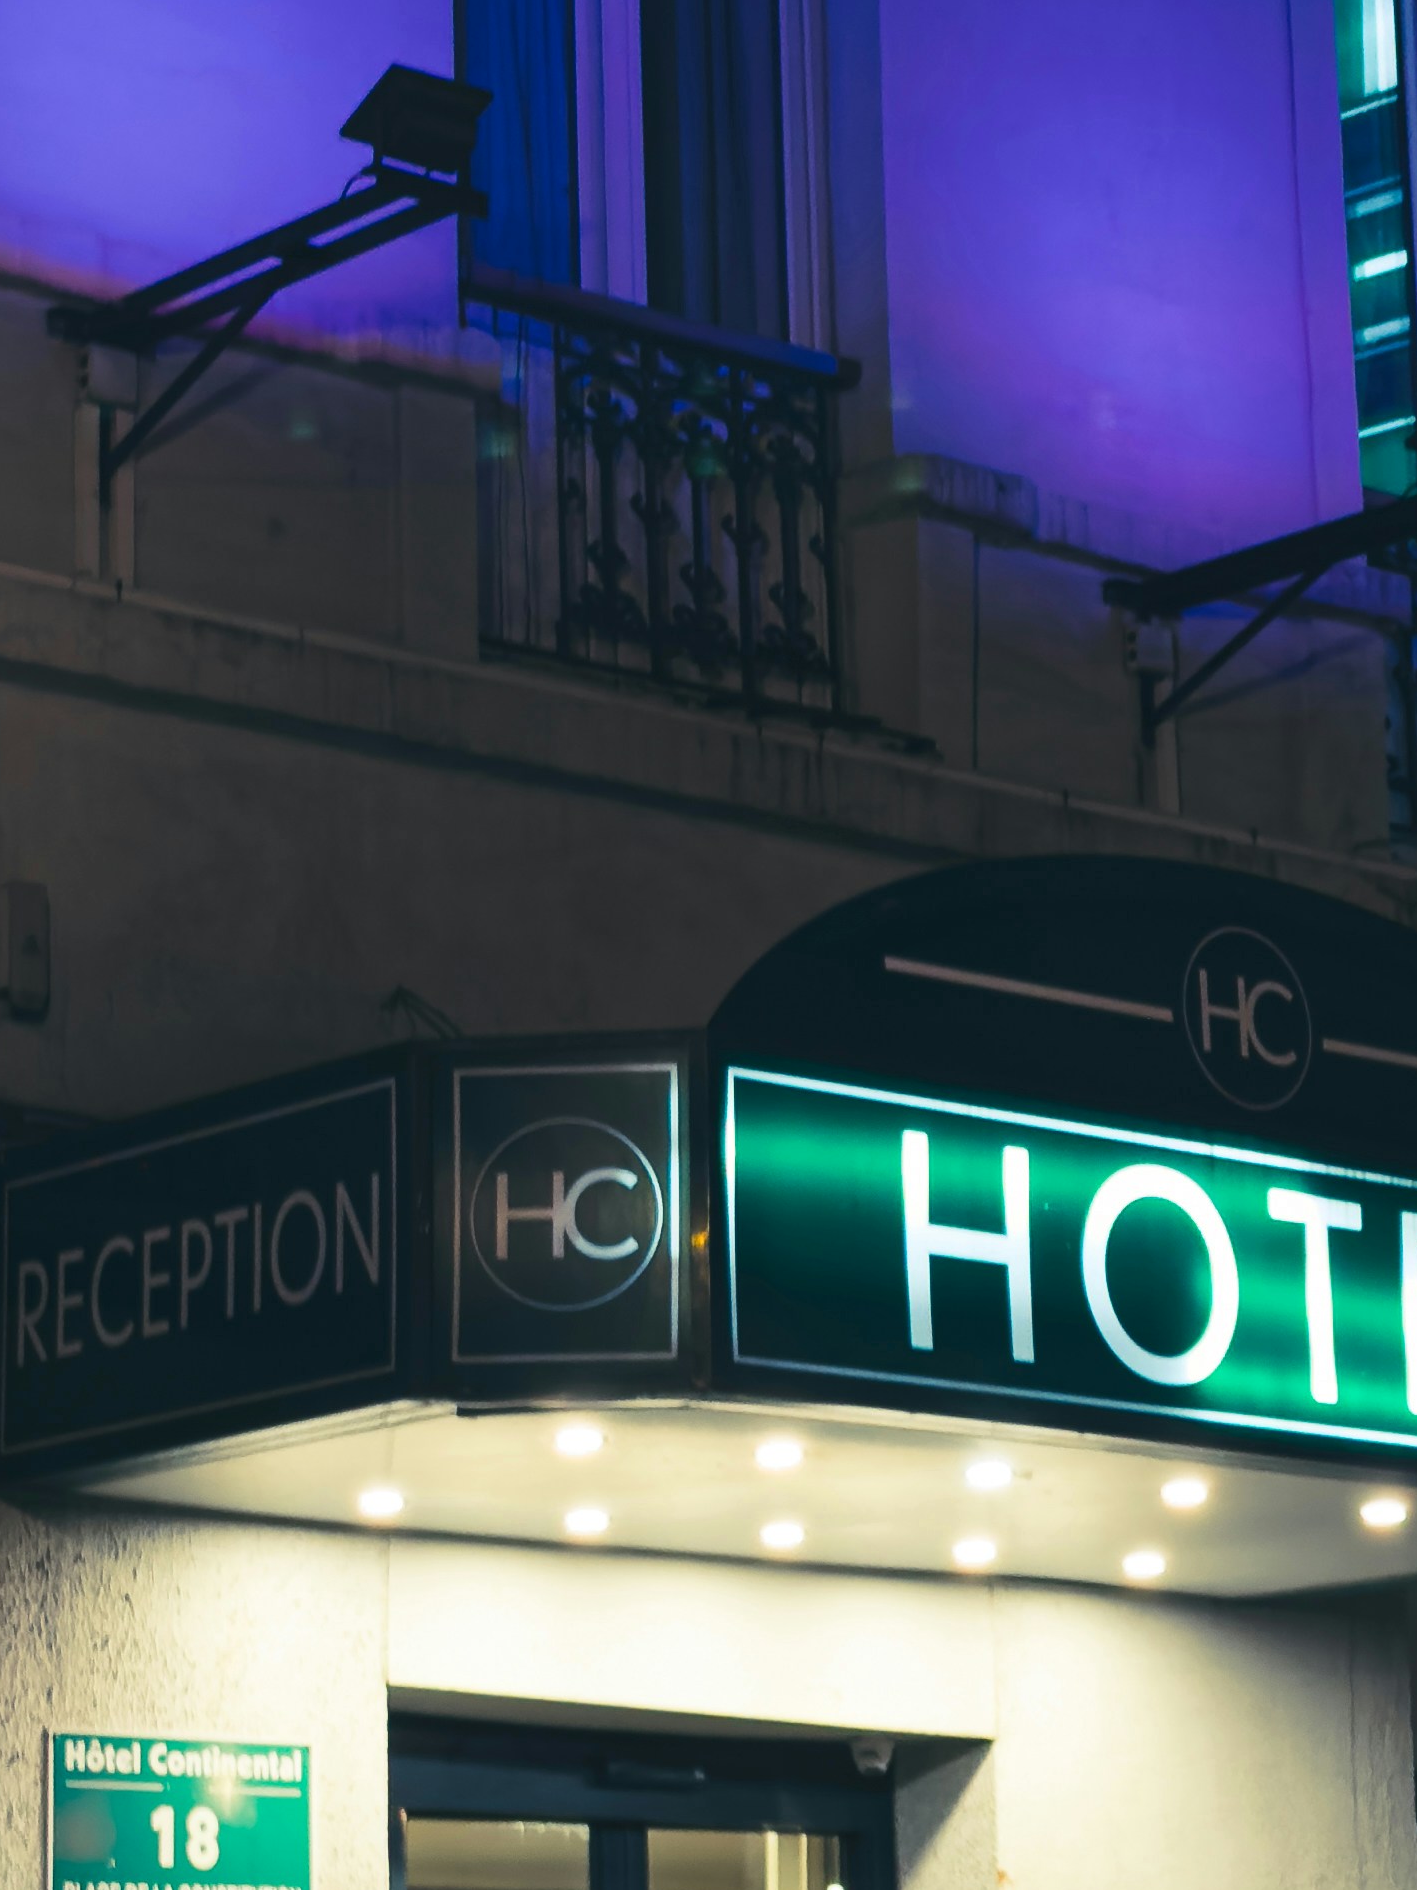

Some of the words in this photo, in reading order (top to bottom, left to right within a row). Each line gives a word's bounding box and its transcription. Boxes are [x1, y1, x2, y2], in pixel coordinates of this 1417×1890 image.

[1198, 968, 1297, 1068] HC
[495, 1167, 639, 1262] HC
[15, 1171, 381, 1368] RECEPTION
[148, 1742, 303, 1783] Continental
[149, 1805, 221, 1872] 18
